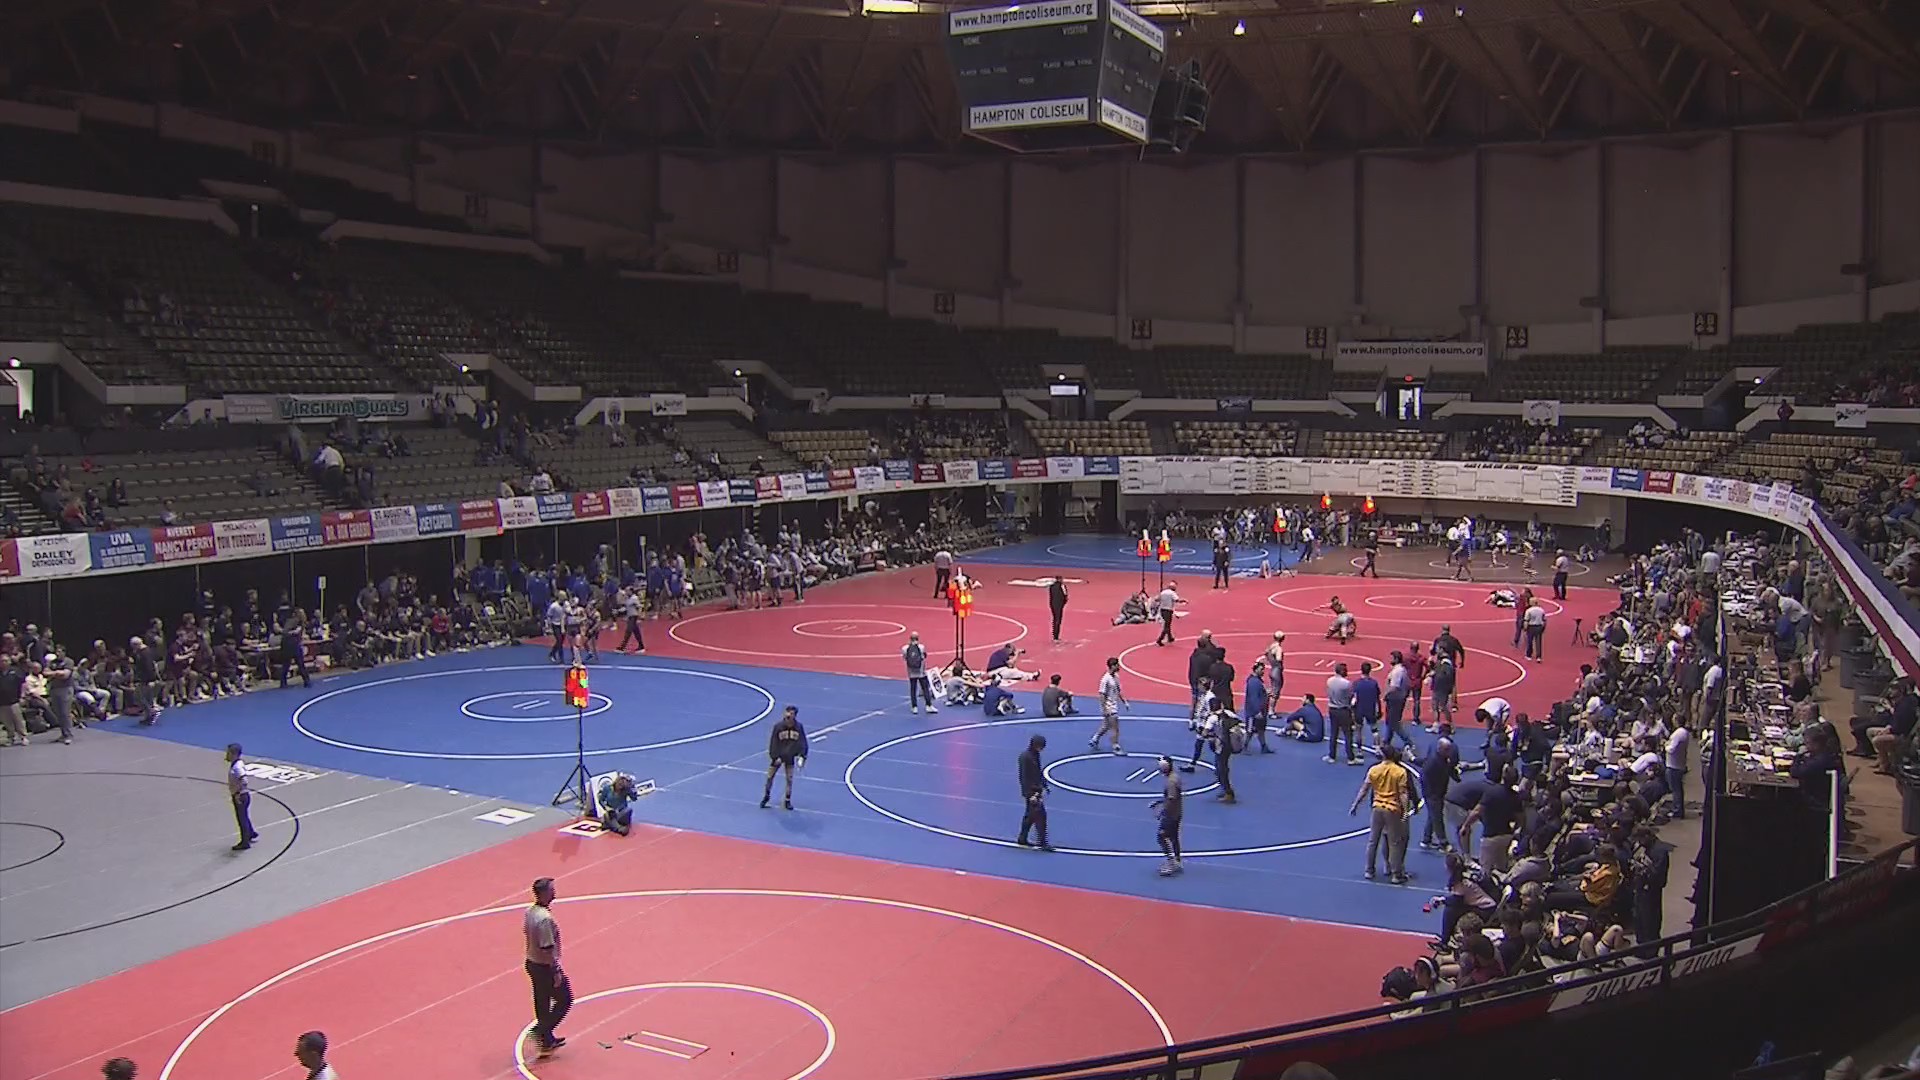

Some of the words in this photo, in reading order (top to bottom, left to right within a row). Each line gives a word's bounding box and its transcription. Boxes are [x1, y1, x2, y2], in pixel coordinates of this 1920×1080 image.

[954, 2, 1094, 28] www.hamptoncoliseum.org
[974, 107, 1024, 123] HAMPTON
[1030, 103, 1085, 119] COLISEUM
[1340, 346, 1483, 356] www.hamptoncoliseum.org
[277, 398, 353, 419] VIRGINIA
[352, 397, 408, 418] DUALS
[110, 532, 133, 545] UVA
[154, 539, 184, 554] NANCY
[186, 536, 213, 550] PERRY
[34, 550, 73, 560] DAILEY
